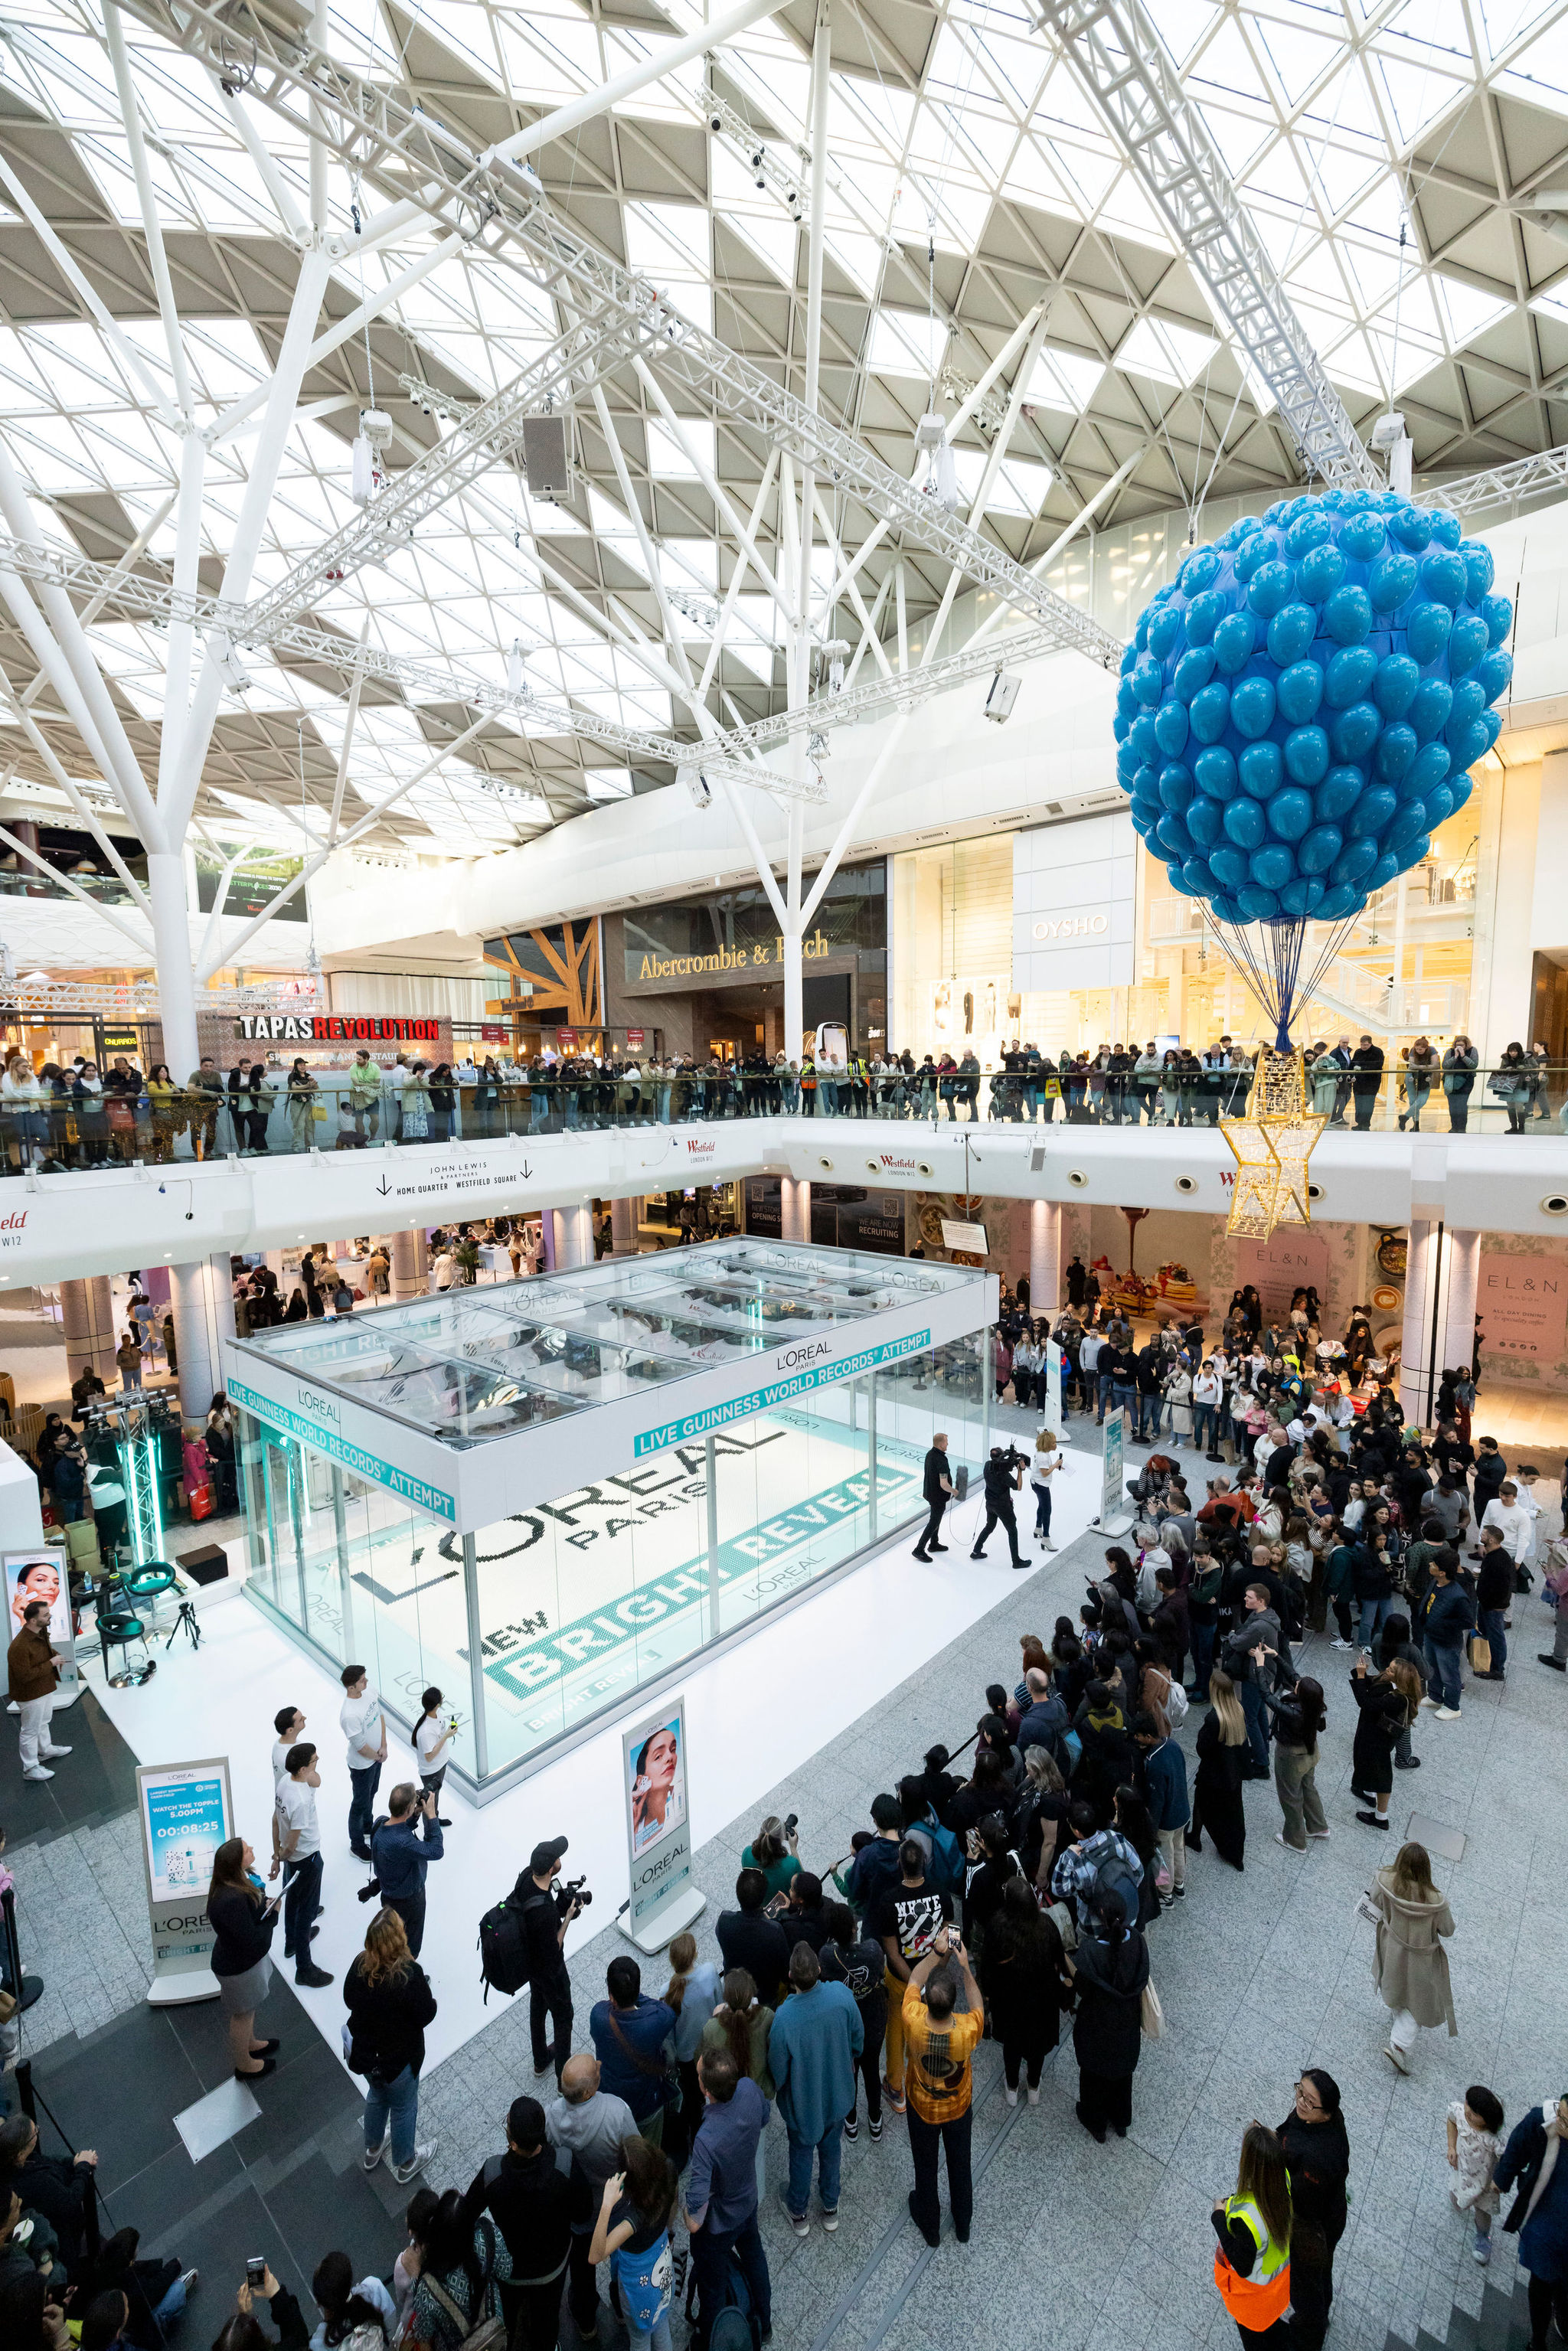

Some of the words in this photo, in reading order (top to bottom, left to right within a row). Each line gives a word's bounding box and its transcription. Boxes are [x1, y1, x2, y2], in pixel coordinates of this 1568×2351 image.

[1033, 916, 1109, 941] OYSHO
[639, 943, 746, 979] Abercrombie
[753, 945, 769, 965] &
[775, 929, 829, 962] Fch
[105, 1037, 136, 1046] CHURROS
[687, 1139, 715, 1154] Westfield
[430, 1165, 455, 1174] JOHN
[459, 1162, 487, 1171] LEWIS
[880, 1155, 916, 1169] Westfield
[397, 1186, 416, 1196] HOME
[418, 1184, 448, 1194] QUARTER
[456, 1177, 491, 1189] WESTFIELD
[494, 1174, 517, 1184] SQUARE
[752, 1213, 776, 1222] OPENING
[883, 1221, 899, 1229] NOW
[2, 1236, 21, 1246] W12
[858, 1226, 899, 1239] RECRUITING
[777, 1341, 832, 1370] L'ORÉAL
[795, 1360, 816, 1372] PARIS
[640, 1424, 678, 1454] LIVE
[683, 1393, 760, 1436] GUINNESS
[765, 1373, 814, 1406] WORLD
[882, 1332, 929, 1362] ATTEMPT
[299, 1389, 341, 1424] L'ORÉAL
[230, 1381, 247, 1403] LIVE
[248, 1392, 289, 1428] GUINNESS
[292, 1415, 327, 1448] WORLD
[389, 1472, 451, 1517] ATTEMPT
[502, 1556, 732, 1687] BRIGHT
[733, 1470, 906, 1560] REVEAL
[528, 1692, 593, 1731] BRIGHT
[595, 1654, 658, 1690] REVEAL
[194, 1799, 220, 1807] TOPPLE
[170, 1807, 203, 1818] 5.00PM
[157, 1820, 219, 1838] 00:08:25
[633, 1843, 688, 1892] L'ORÉAL
[154, 1913, 211, 1933] L'ORÉ
